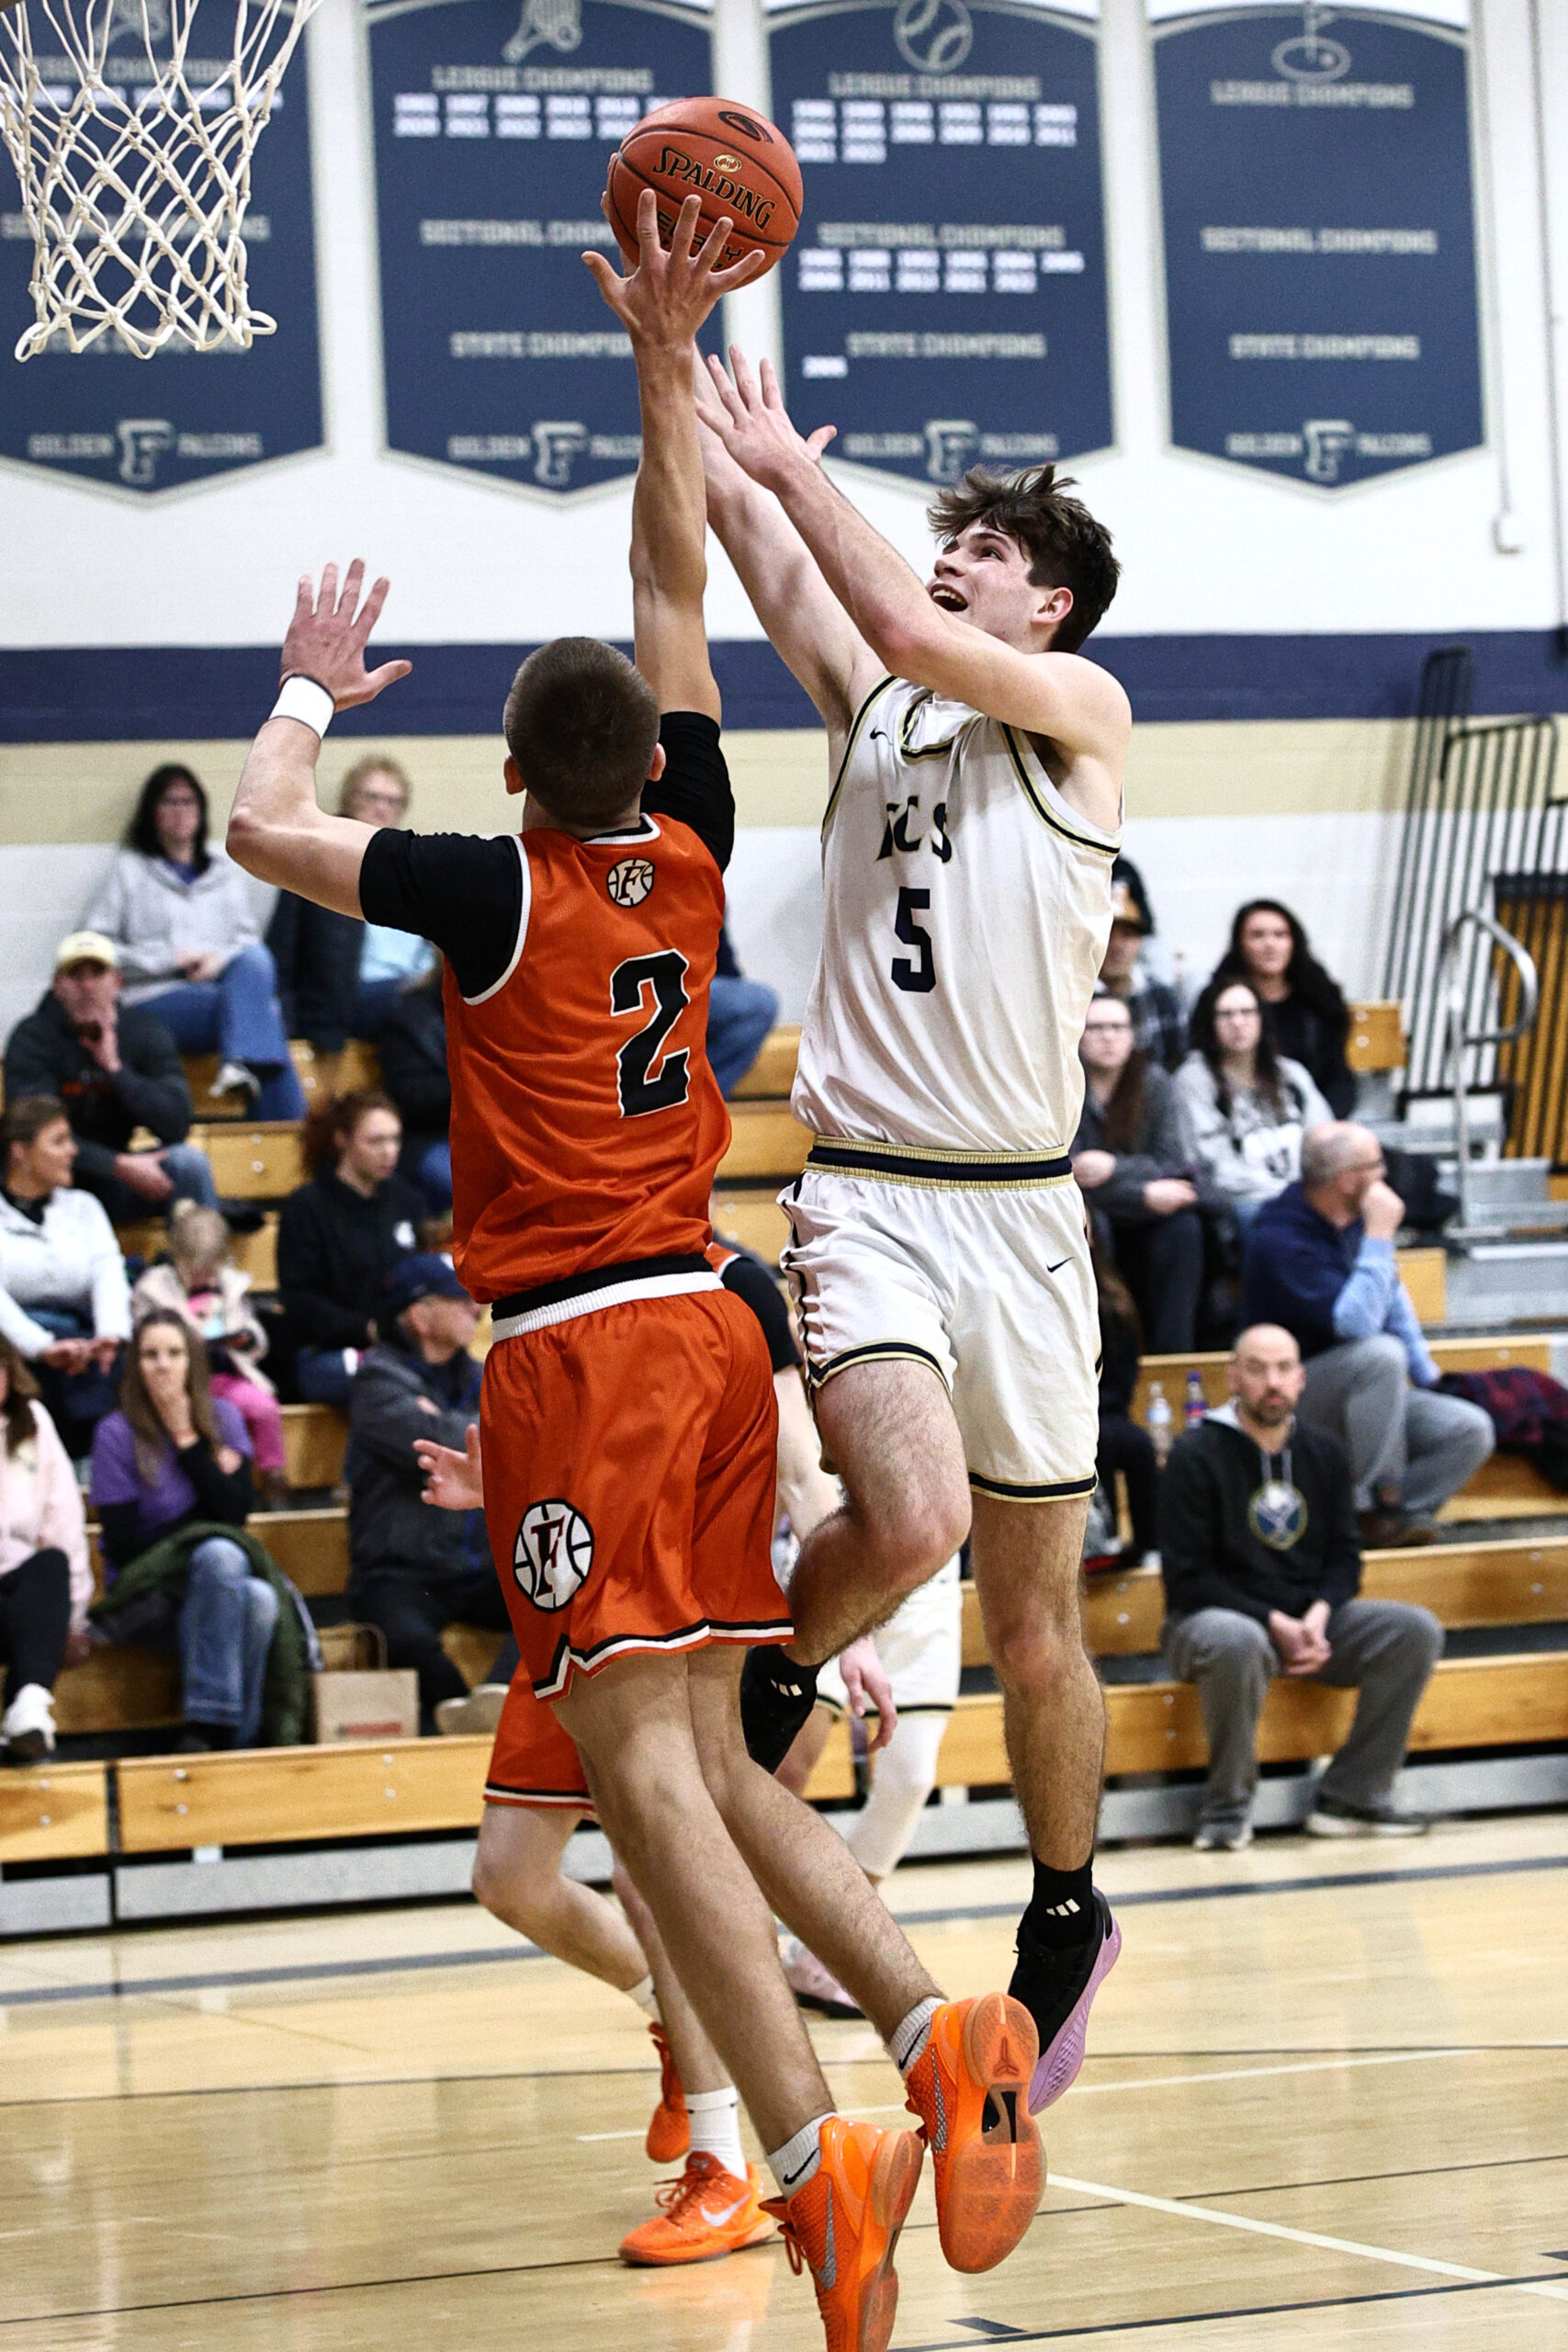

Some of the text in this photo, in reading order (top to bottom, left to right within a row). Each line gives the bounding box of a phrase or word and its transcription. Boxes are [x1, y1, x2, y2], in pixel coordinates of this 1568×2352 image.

[653, 146, 776, 232] SPALDING
[891, 886, 937, 993] 5
[610, 947, 691, 1119] 2
